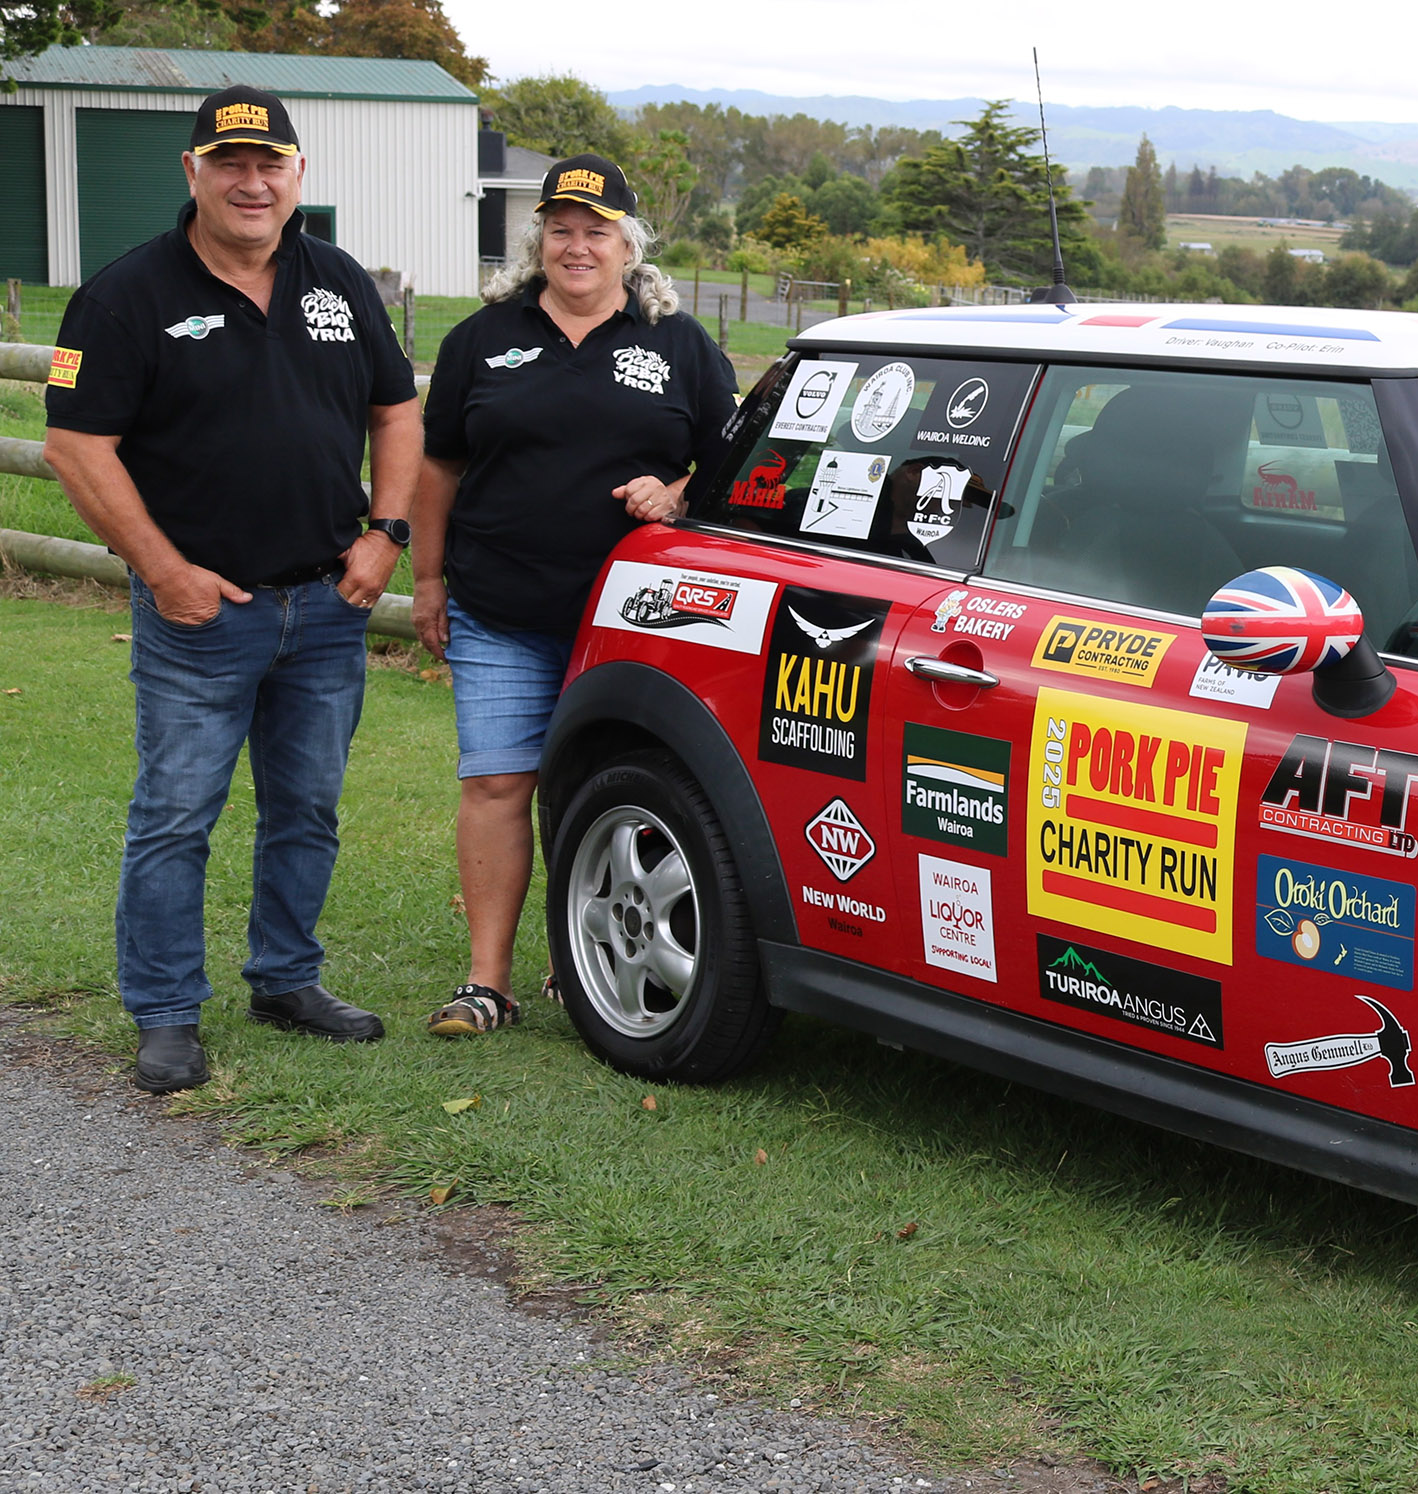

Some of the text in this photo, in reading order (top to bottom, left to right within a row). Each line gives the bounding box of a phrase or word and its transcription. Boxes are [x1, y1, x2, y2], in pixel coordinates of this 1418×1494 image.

[223, 103, 250, 116] PORK
[251, 105, 268, 117] PIE
[216, 117, 268, 128] CHARITY RUN
[1165, 337, 1345, 354] Driver: Vaughan Co-Pilot: Erin
[613, 370, 664, 395] YROA
[863, 365, 894, 392] WAIROA
[895, 365, 909, 379] CLUB
[802, 390, 826, 398] VOLVO
[775, 421, 828, 433] EVEREST CONTRACTING
[917, 430, 990, 447] WAIROA WELDING
[916, 528, 940, 537] WAIROA
[675, 585, 718, 607] QRS
[966, 596, 1027, 619] OSLERS
[953, 615, 1015, 641] BAKERY
[1083, 627, 1163, 658] PRYDE
[1077, 649, 1149, 671] CONTRACTING
[775, 653, 861, 723] KAHU
[1198, 676, 1216, 685] FARMS
[1209, 686, 1235, 695] ZEALAND
[771, 716, 855, 760] SCAFFOLDING
[1042, 716, 1067, 809] 2025
[1066, 722, 1226, 816] PORK PIE
[906, 779, 1004, 824] Farmlands
[937, 816, 974, 838] Wairoa
[1262, 808, 1384, 844] CONTRACTING
[820, 823, 862, 856] NW
[1040, 819, 1217, 902] CHARITY RUN
[932, 871, 979, 895] WAIROA
[802, 885, 886, 924] NEW WORLD
[1274, 867, 1401, 928] Otoki Orchard
[827, 915, 863, 938] Wairoa
[929, 899, 985, 931] LIQUOR
[940, 926, 976, 946] CENTRE
[931, 944, 991, 969] SUPPORTING LOCAL!
[1122, 1010, 1135, 1019] TRIED
[1140, 1015, 1159, 1026] PROVEN
[1160, 1021, 1174, 1030] SINCE
[1272, 1051, 1310, 1067] Angus
[1311, 1040, 1364, 1062] Gemmell
